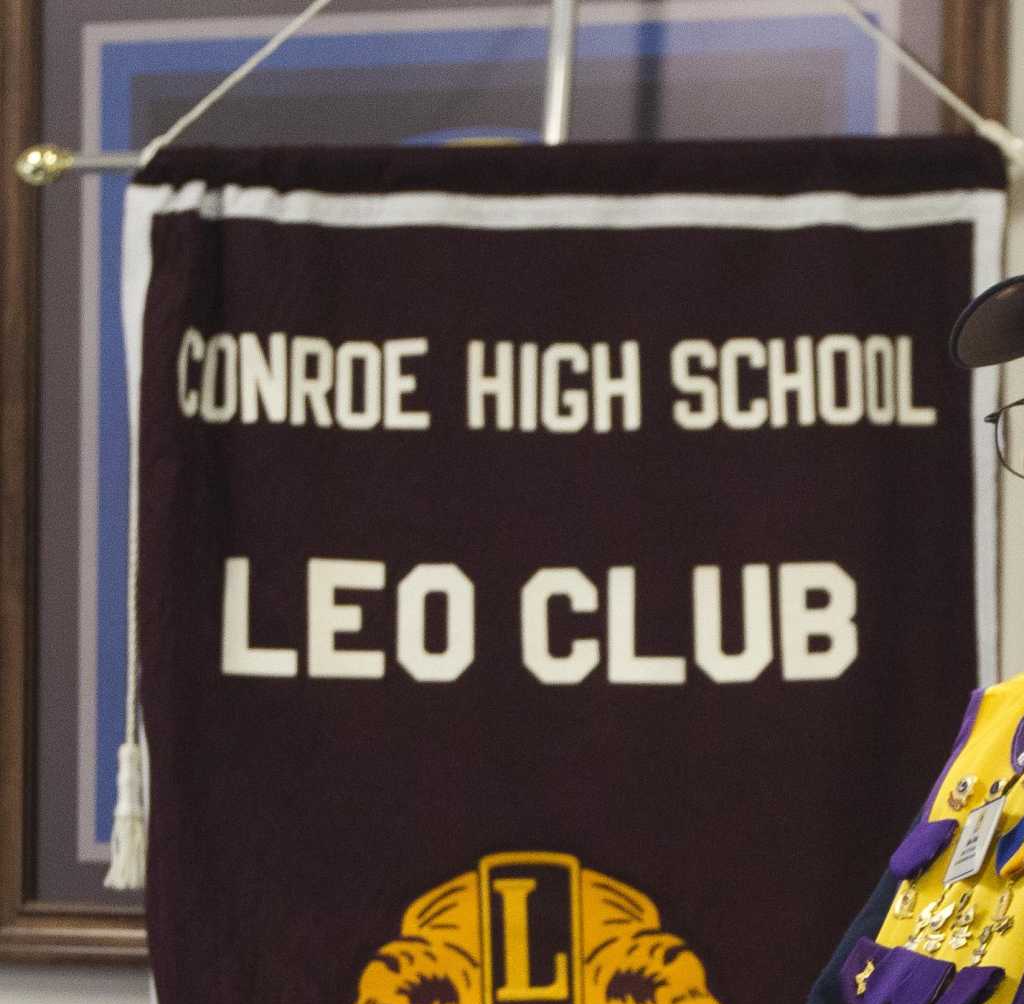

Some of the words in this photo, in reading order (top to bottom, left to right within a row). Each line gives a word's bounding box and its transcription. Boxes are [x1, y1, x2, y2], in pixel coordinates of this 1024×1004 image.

[176, 326, 431, 431] CONROE
[467, 340, 642, 433] HIGH
[671, 333, 938, 430] SCHOOL
[221, 556, 476, 684] LEO
[520, 561, 859, 686] CLUB
